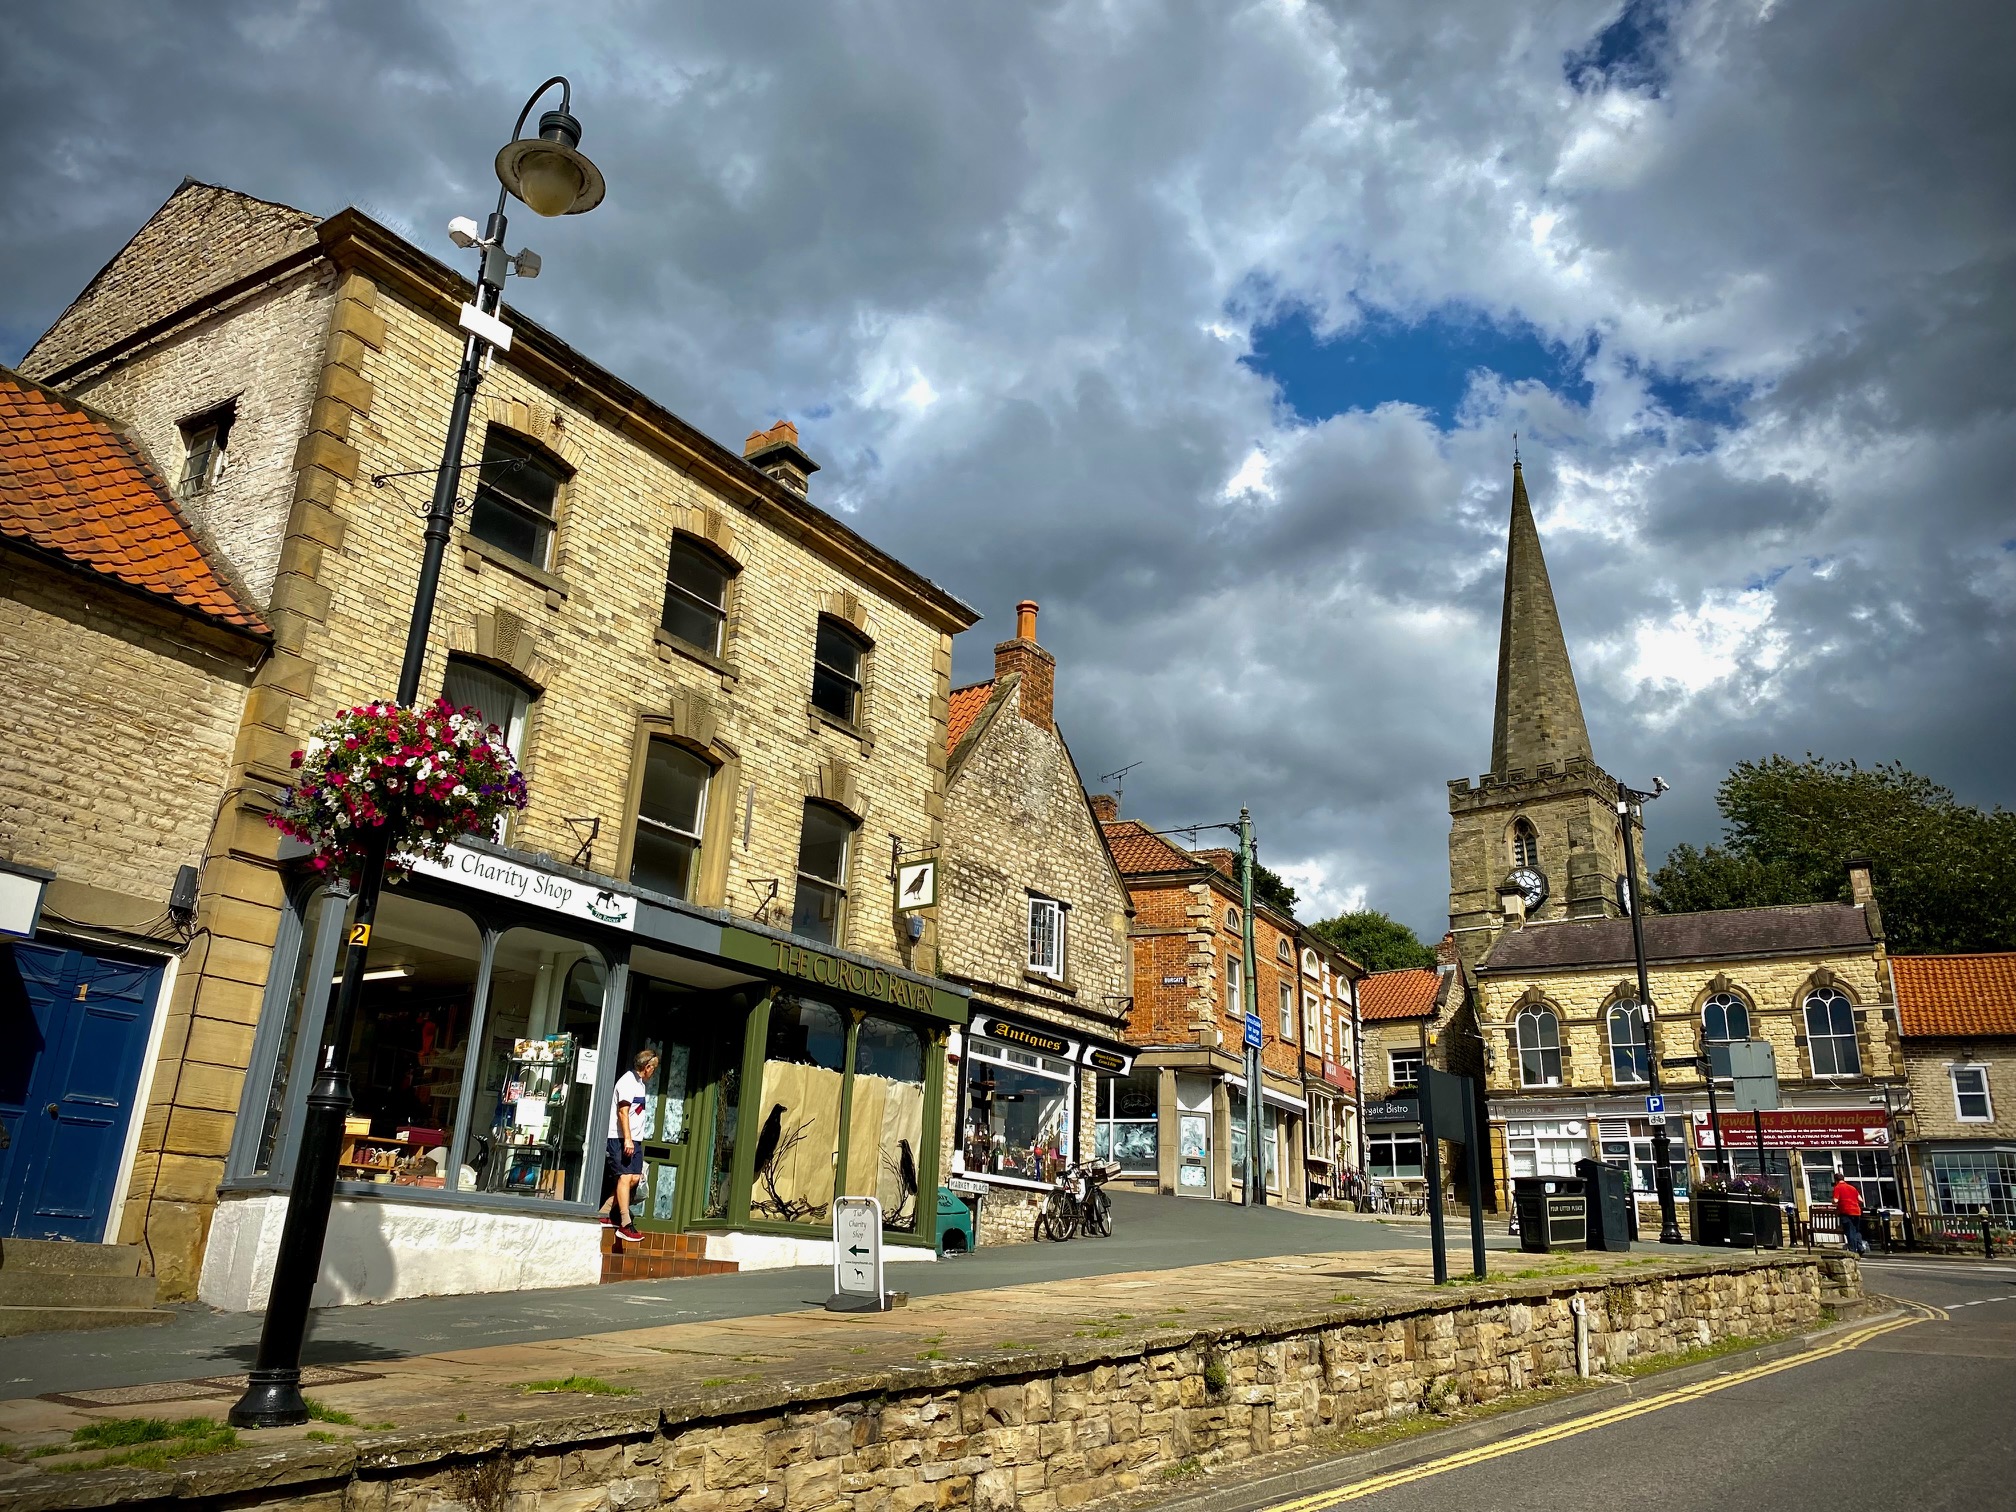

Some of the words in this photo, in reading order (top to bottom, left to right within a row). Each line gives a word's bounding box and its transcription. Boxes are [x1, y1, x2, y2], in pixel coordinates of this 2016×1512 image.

[461, 853, 529, 898] Charity
[533, 875, 573, 909] Shop
[350, 924, 366, 944] 2
[771, 939, 809, 978] THE
[813, 956, 884, 997] CURIOUS
[887, 973, 935, 1013] RAVEN
[74, 983, 88, 1001] 1
[994, 1023, 1062, 1051] Antiques
[1386, 1102, 1409, 1114] Bistro
[1649, 1098, 1660, 1111] P
[1718, 1113, 1775, 1129] Jewellrs
[1781, 1115, 1790, 1126] &
[1791, 1113, 1884, 1126] Watchmakers
[950, 1179, 970, 1191] MARKET
[973, 1183, 988, 1193] PLACE
[848, 1220, 867, 1231] Charity
[852, 1231, 864, 1242] Shop
